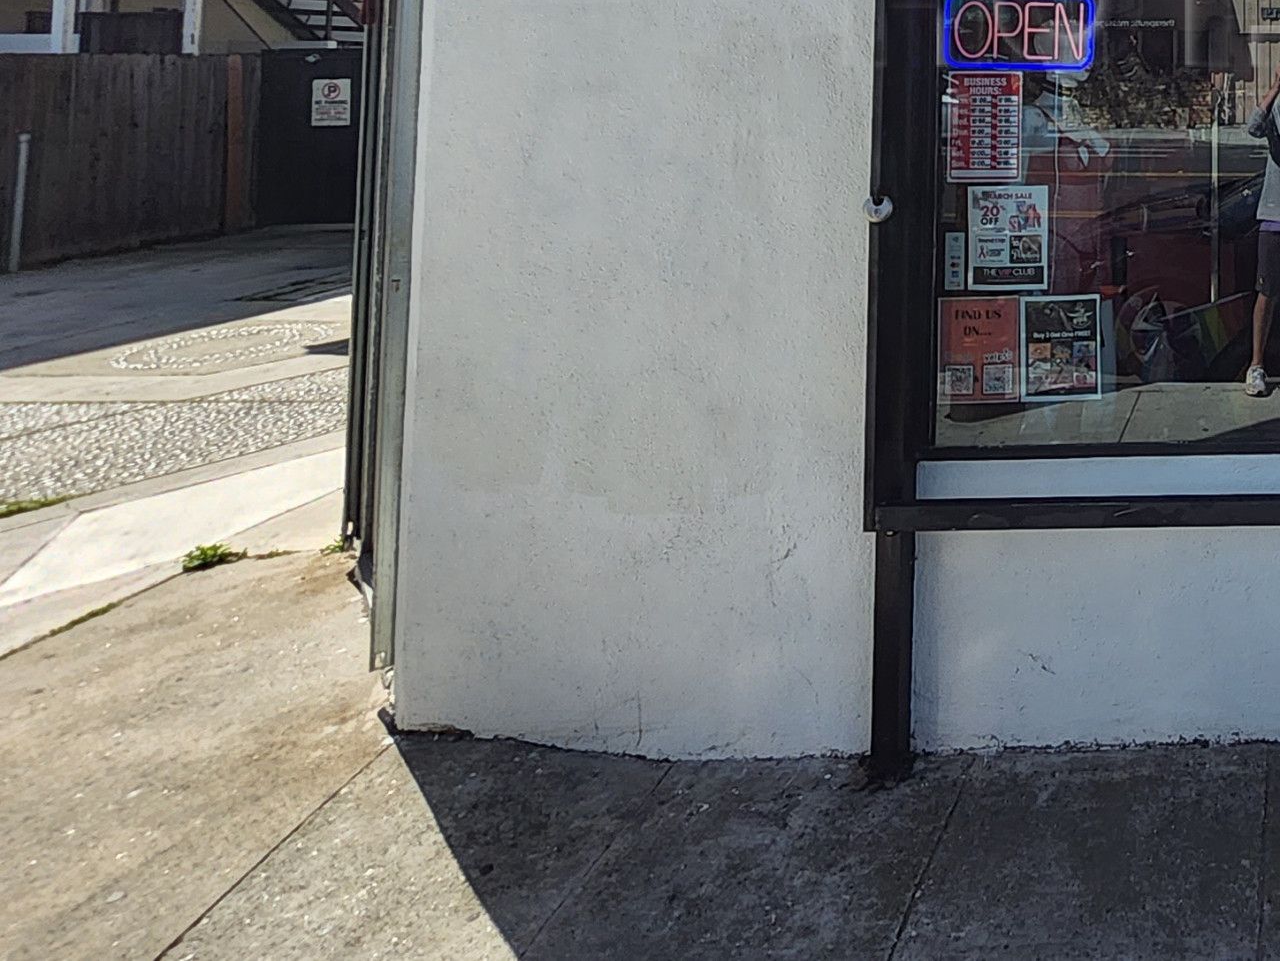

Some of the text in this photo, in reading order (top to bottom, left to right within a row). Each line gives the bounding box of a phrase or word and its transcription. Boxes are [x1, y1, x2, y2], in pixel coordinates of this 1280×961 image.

[953, 0, 1085, 61] OPEN
[964, 78, 1007, 86] BUSINESS
[970, 87, 1002, 95] HOURS:
[1014, 192, 1032, 200] SALE
[980, 217, 1000, 226] OFF
[1012, 268, 1036, 276] CLUB
[954, 309, 1002, 320] FIND US
